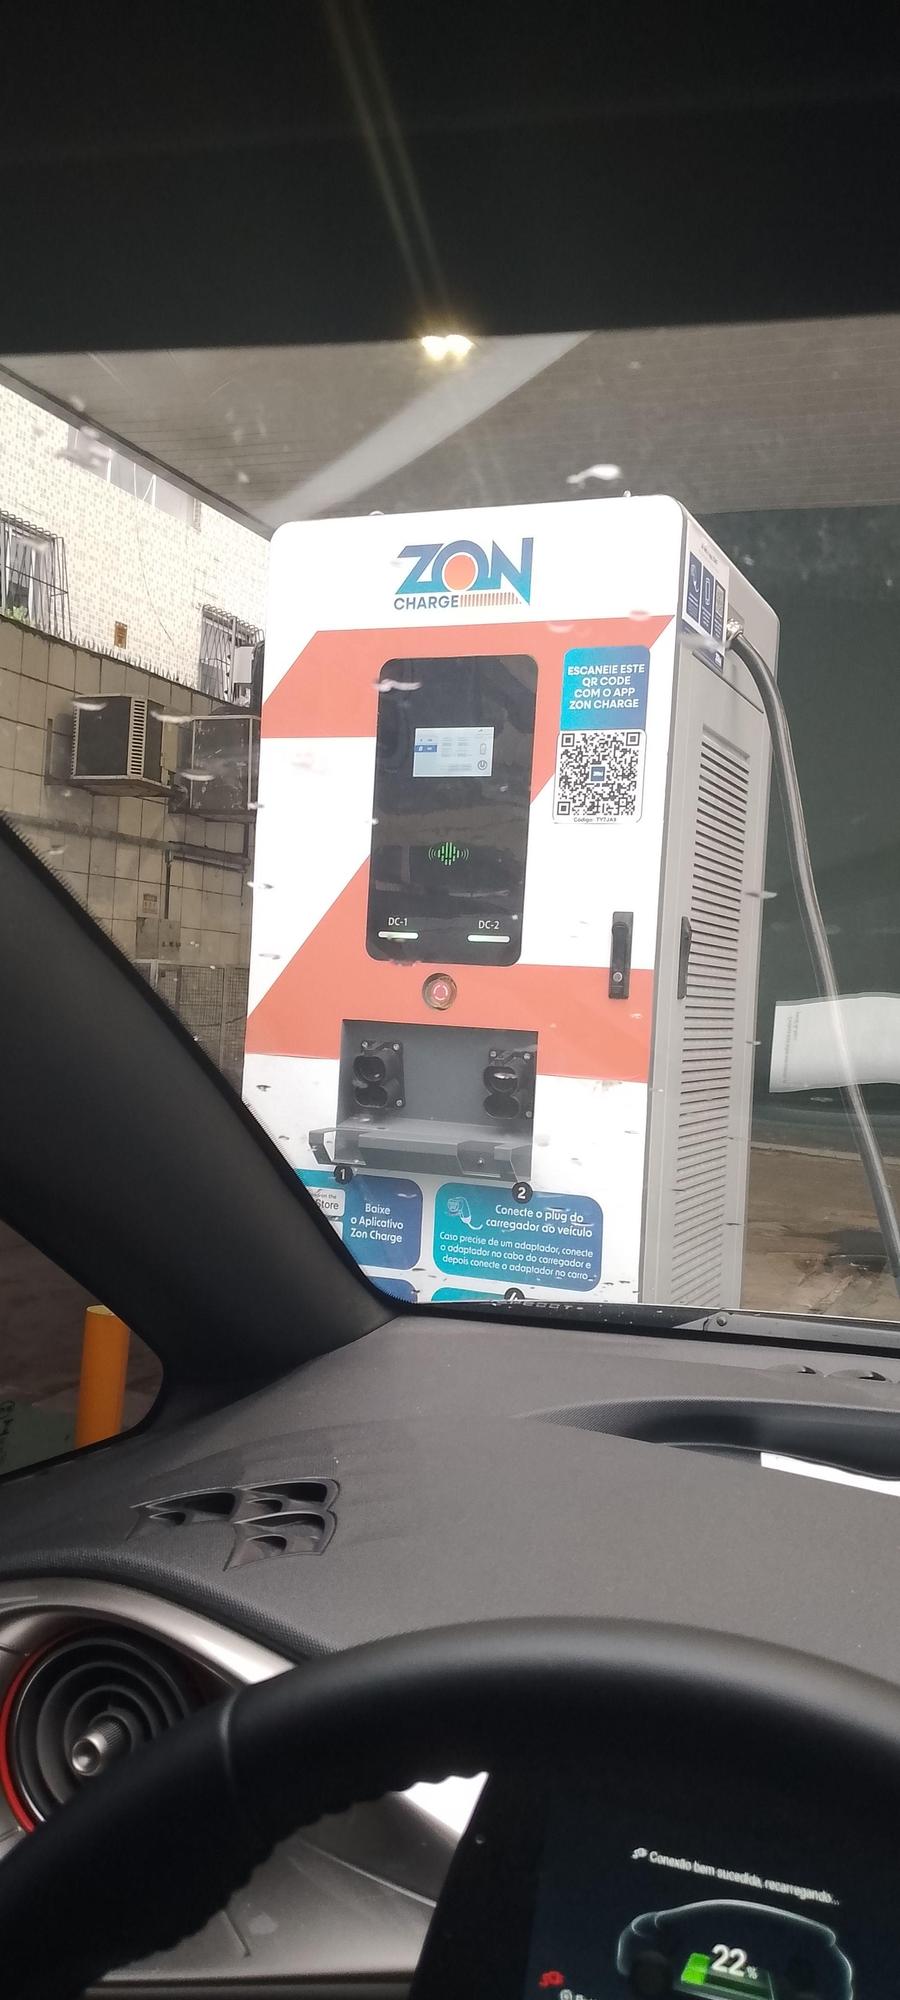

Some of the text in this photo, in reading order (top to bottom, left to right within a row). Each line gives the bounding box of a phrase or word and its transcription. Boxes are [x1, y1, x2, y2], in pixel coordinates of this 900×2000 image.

[395, 537, 534, 605] ZON
[394, 595, 459, 610] CHARGE
[567, 663, 645, 676] ESCANEIE ESTE
[582, 675, 631, 687] QR CODE
[574, 687, 635, 698] COM O APP
[568, 698, 639, 710] ZON CHARGE
[388, 917, 408, 926] DC-1
[478, 920, 500, 930] DC-2
[340, 1168, 346, 1180] 1
[517, 1186, 526, 1200] 2
[315, 1198, 339, 1210] Store
[365, 1203, 391, 1215] Baixe
[495, 1204, 533, 1218] Conecte
[544, 1209, 568, 1223] plug
[570, 1212, 584, 1223] do
[350, 1216, 404, 1230] o Aplicativo
[485, 1219, 592, 1237] carregador ao veículo
[350, 1228, 403, 1244] Zon Charge
[440, 1231, 458, 1241] Caso
[460, 1235, 486, 1245] precise
[487, 1237, 499, 1246] de
[514, 1241, 560, 1255] adaptador,
[561, 1247, 593, 1258] conecte
[447, 1244, 490, 1257] adaptador
[491, 1250, 502, 1258] no
[503, 1251, 524, 1260] cabo
[525, 1253, 537, 1262] do
[538, 1256, 584, 1268] carregador
[442, 1254, 469, 1265] depois
[470, 1259, 500, 1269] conecte
[509, 1263, 553, 1276] adaptador
[555, 1269, 566, 1277] no
[693, 1860, 715, 1877] bem
